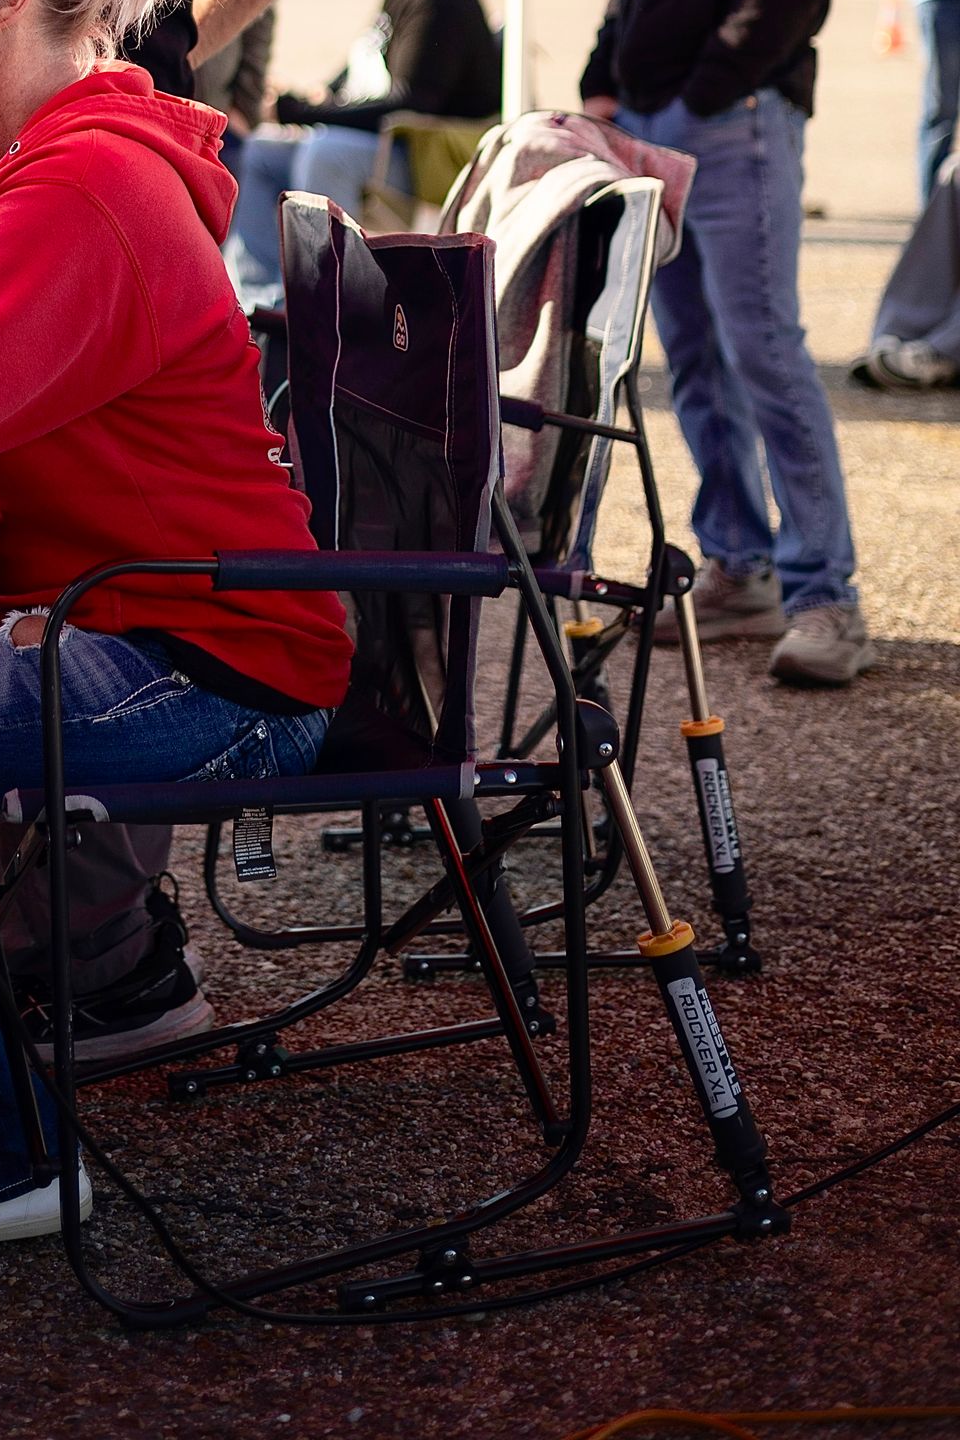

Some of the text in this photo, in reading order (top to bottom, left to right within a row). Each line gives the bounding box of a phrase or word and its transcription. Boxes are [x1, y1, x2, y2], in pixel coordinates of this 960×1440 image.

[702, 770, 728, 861] ROCKER XL
[718, 770, 741, 860] FREESTYLE
[678, 993, 727, 1104] ROCKER XL
[697, 986, 742, 1097] FREESTYLE
